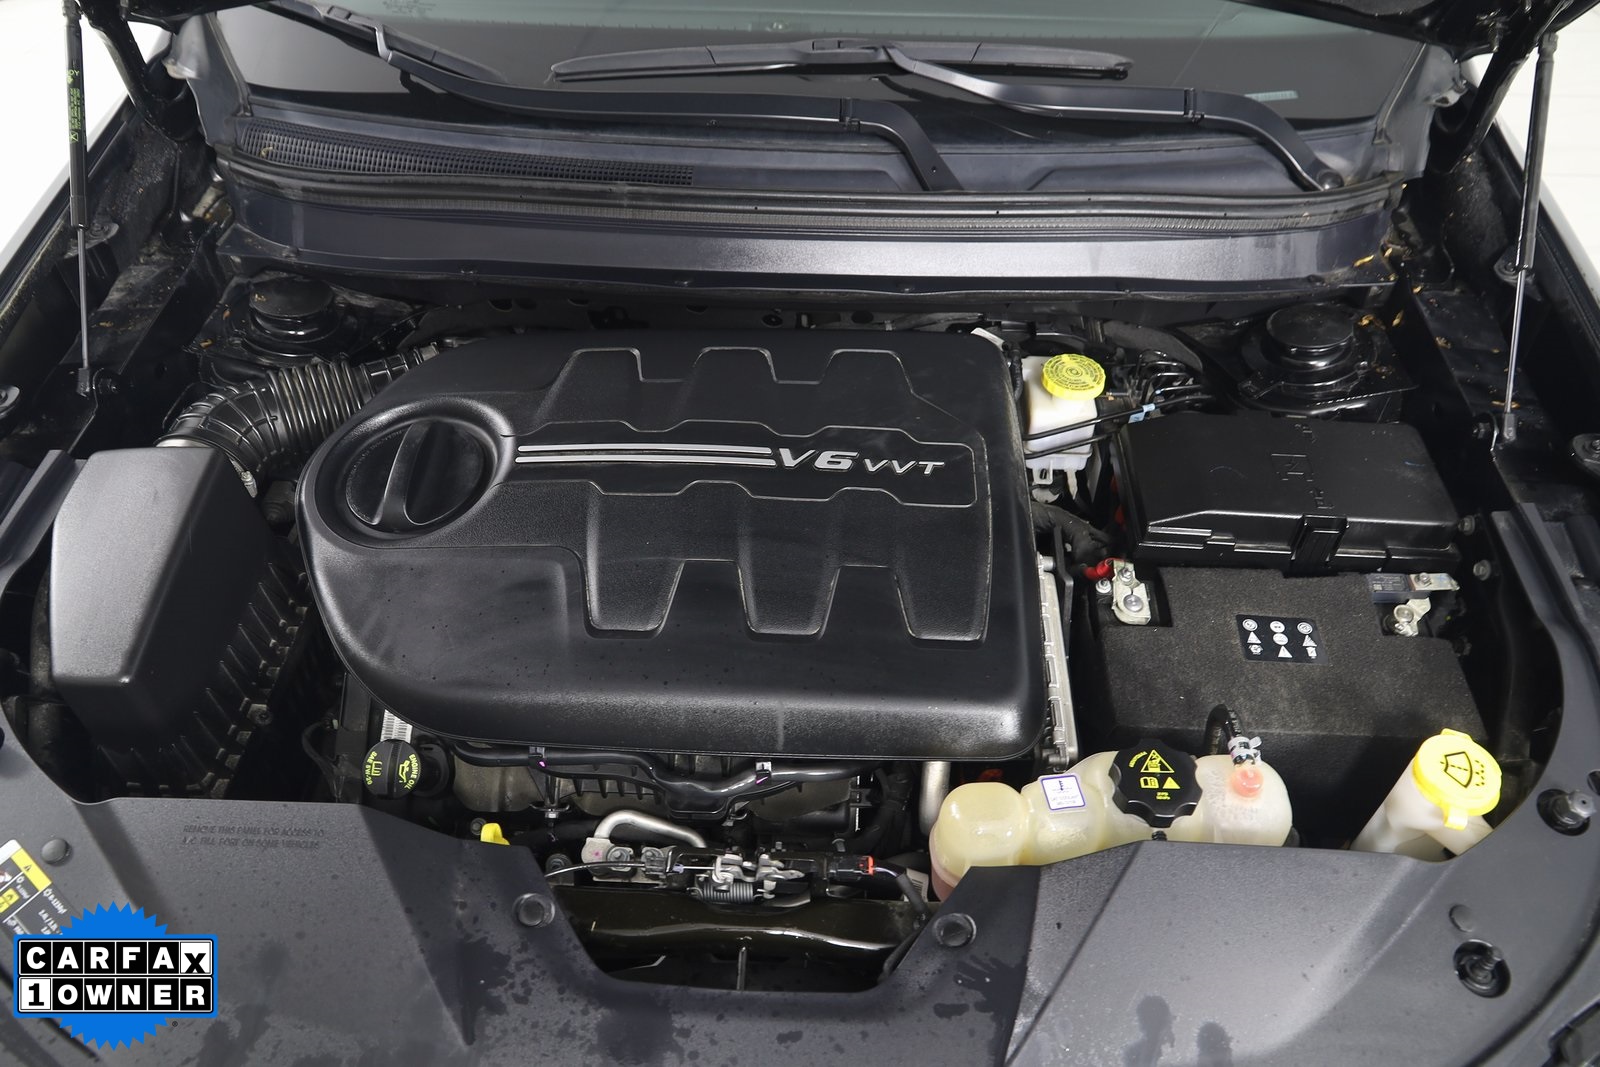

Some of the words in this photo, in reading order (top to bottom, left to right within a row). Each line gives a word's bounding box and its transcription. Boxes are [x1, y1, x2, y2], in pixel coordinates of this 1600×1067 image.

[778, 447, 860, 472] V6
[864, 458, 946, 475] VVT
[367, 751, 377, 763] SAE
[409, 754, 419, 778] ENGINE
[404, 779, 415, 790] OIL
